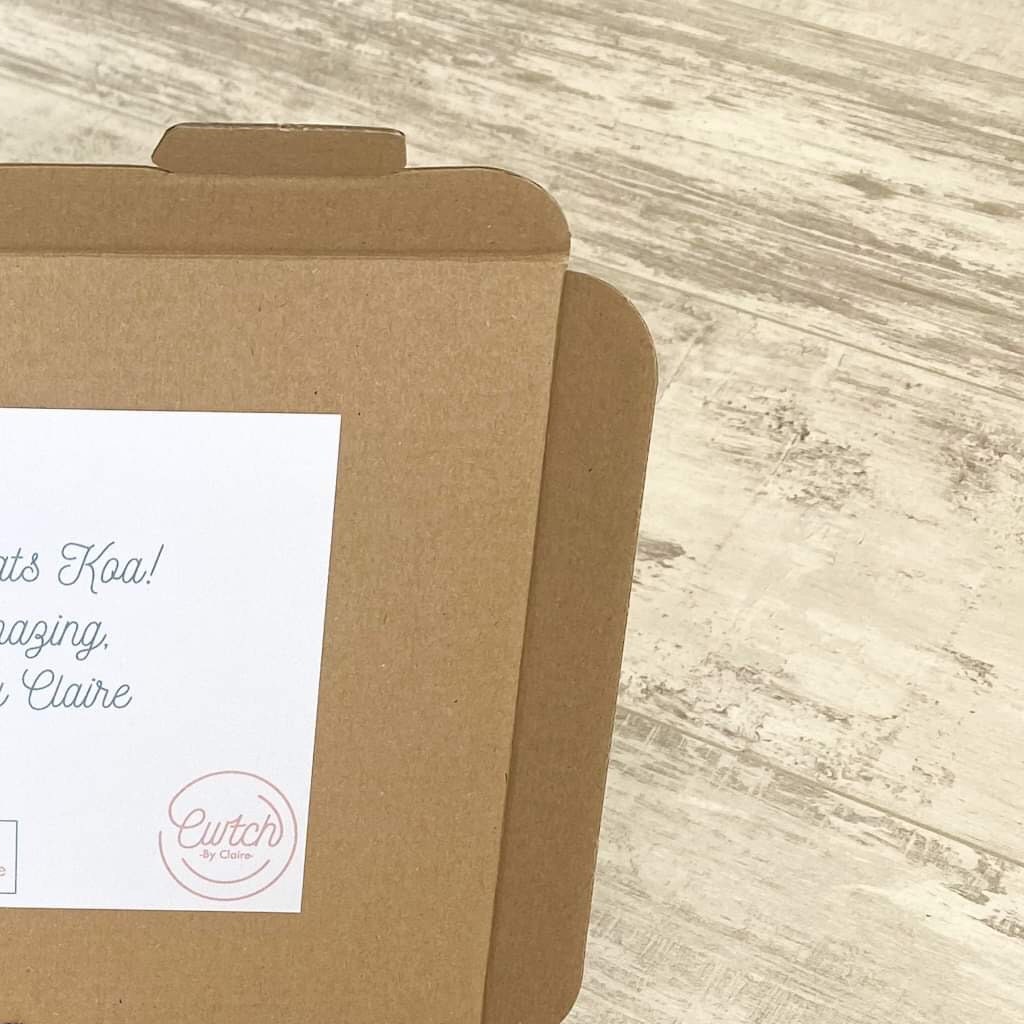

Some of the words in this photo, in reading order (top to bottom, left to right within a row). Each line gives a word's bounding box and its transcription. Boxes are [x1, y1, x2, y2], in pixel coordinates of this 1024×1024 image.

[58, 541, 165, 594] Koa!
[22, 668, 133, 710] Claire
[177, 807, 283, 849] Cwtch
